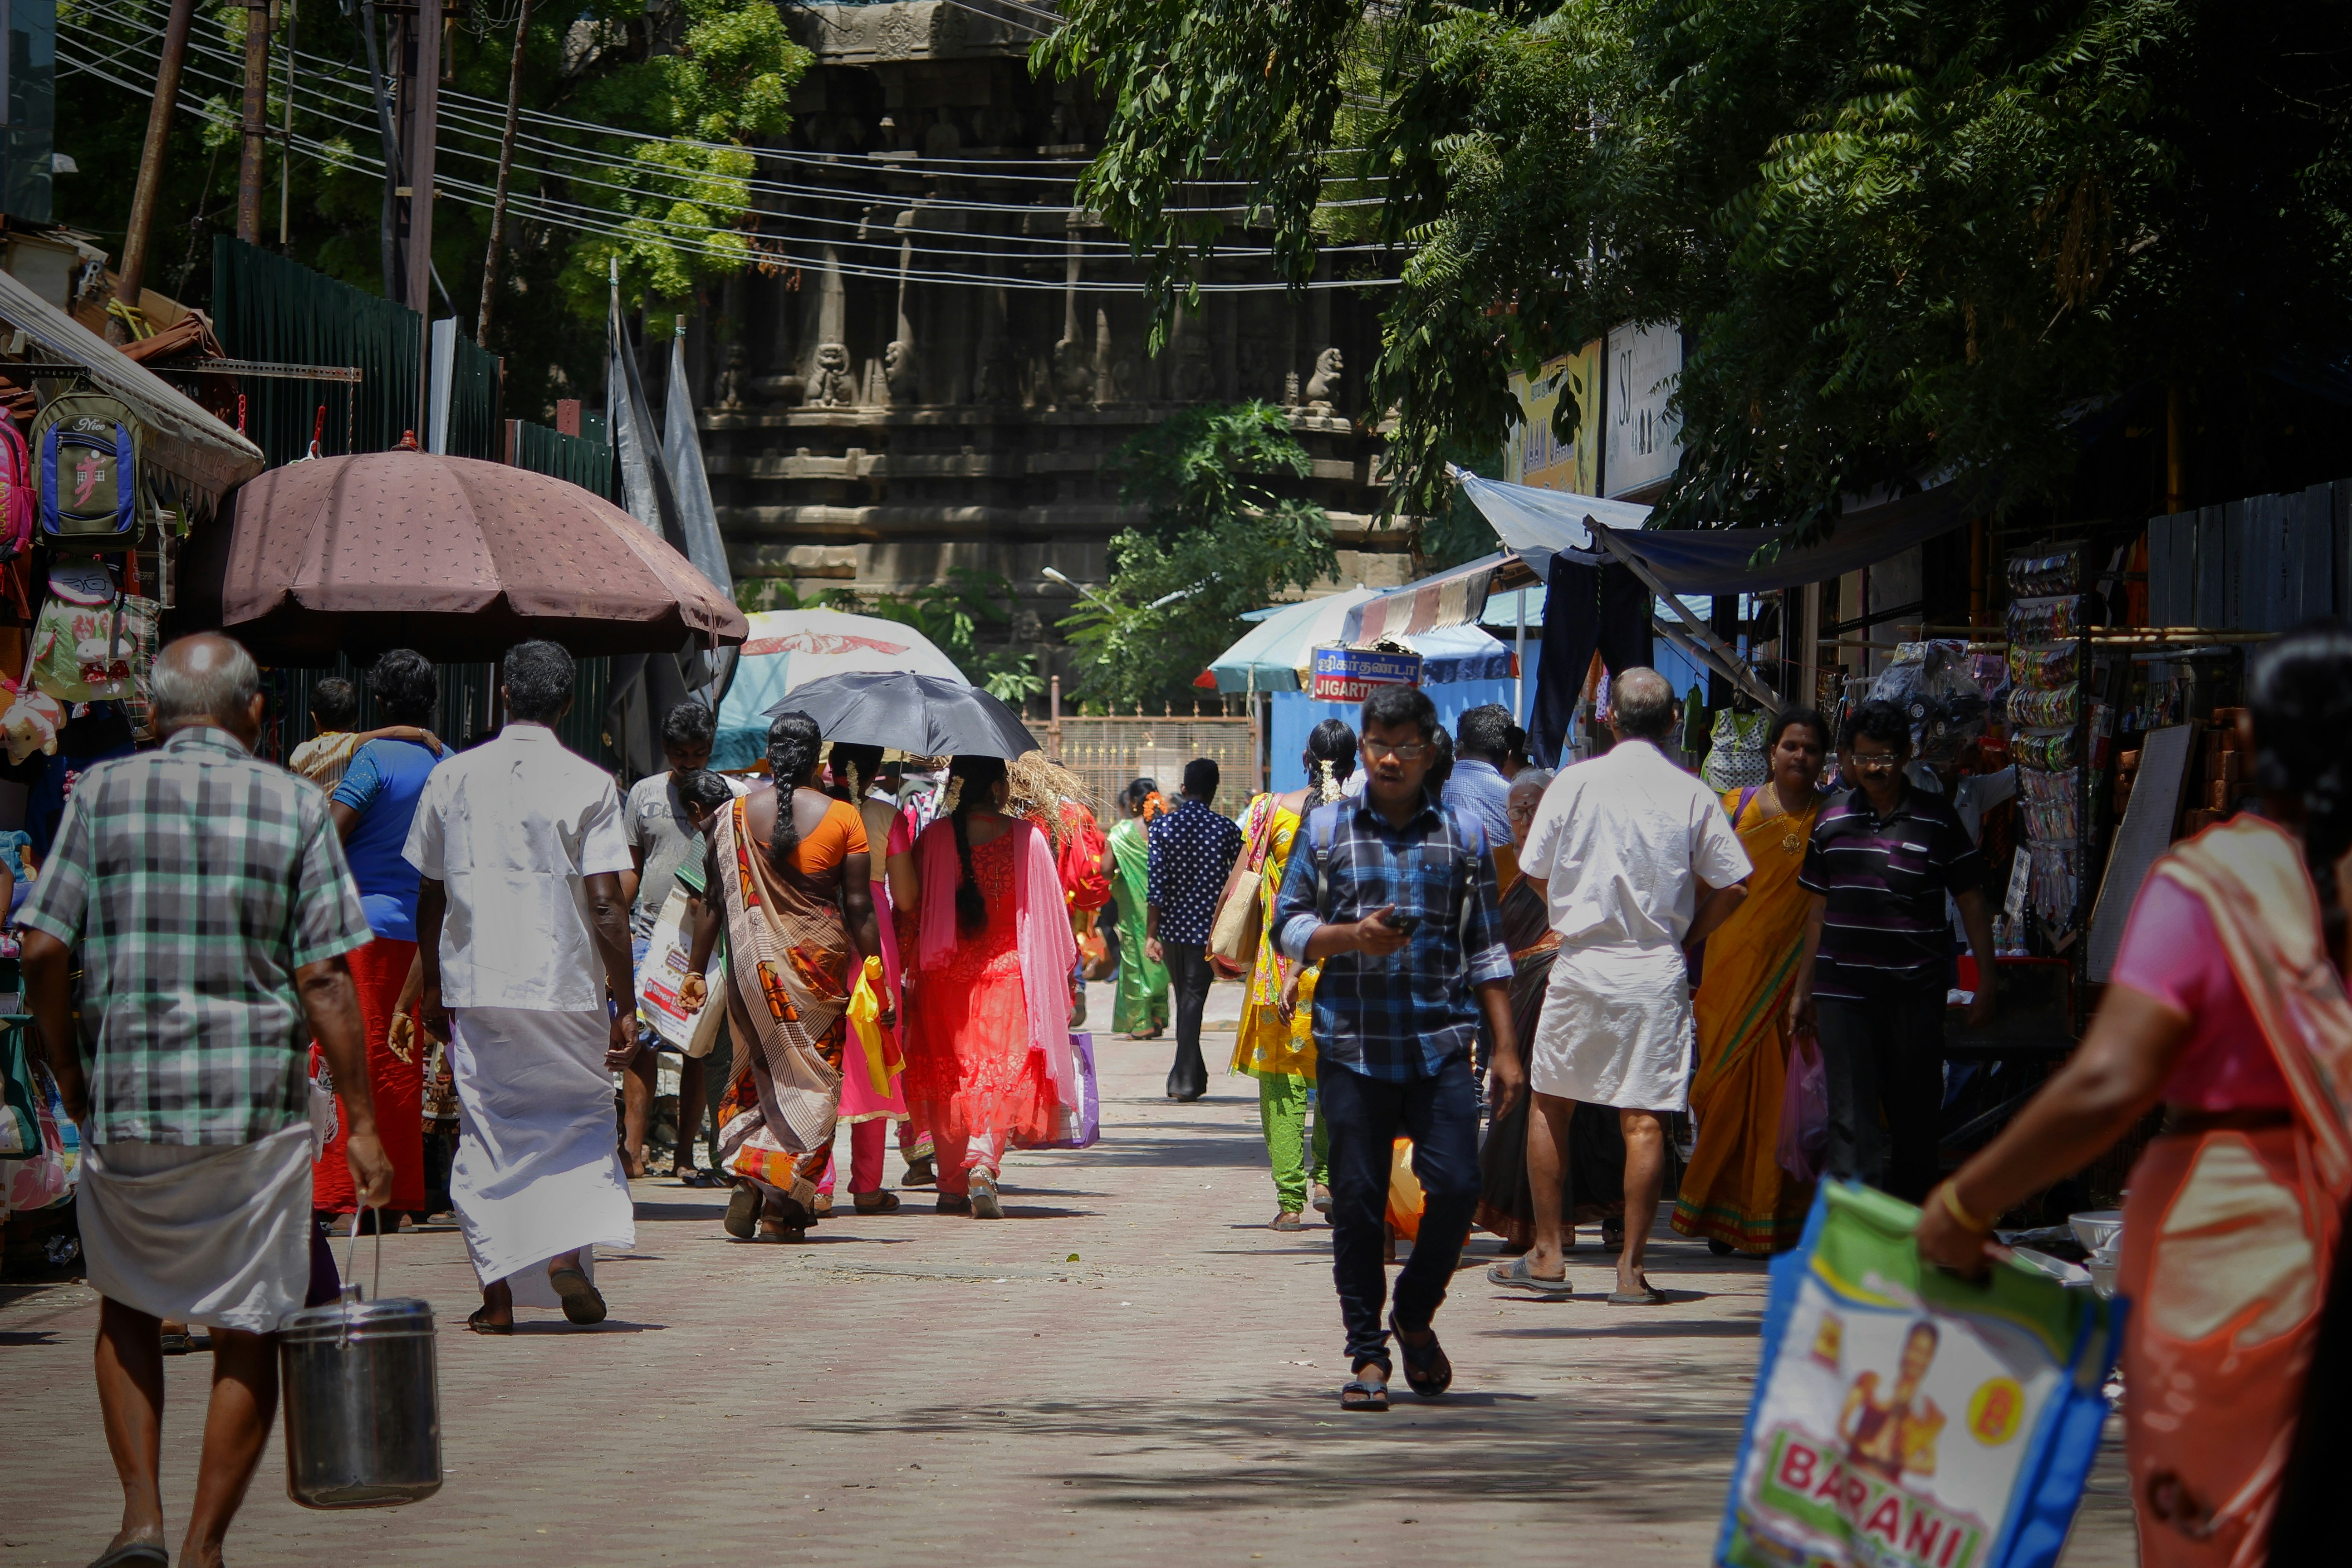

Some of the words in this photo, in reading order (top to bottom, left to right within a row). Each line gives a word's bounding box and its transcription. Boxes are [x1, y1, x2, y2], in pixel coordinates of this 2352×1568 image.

[73, 417, 106, 431] Nice
[1316, 679, 1380, 698] JIGARTH
[1778, 1441, 1962, 1568] BARANI
